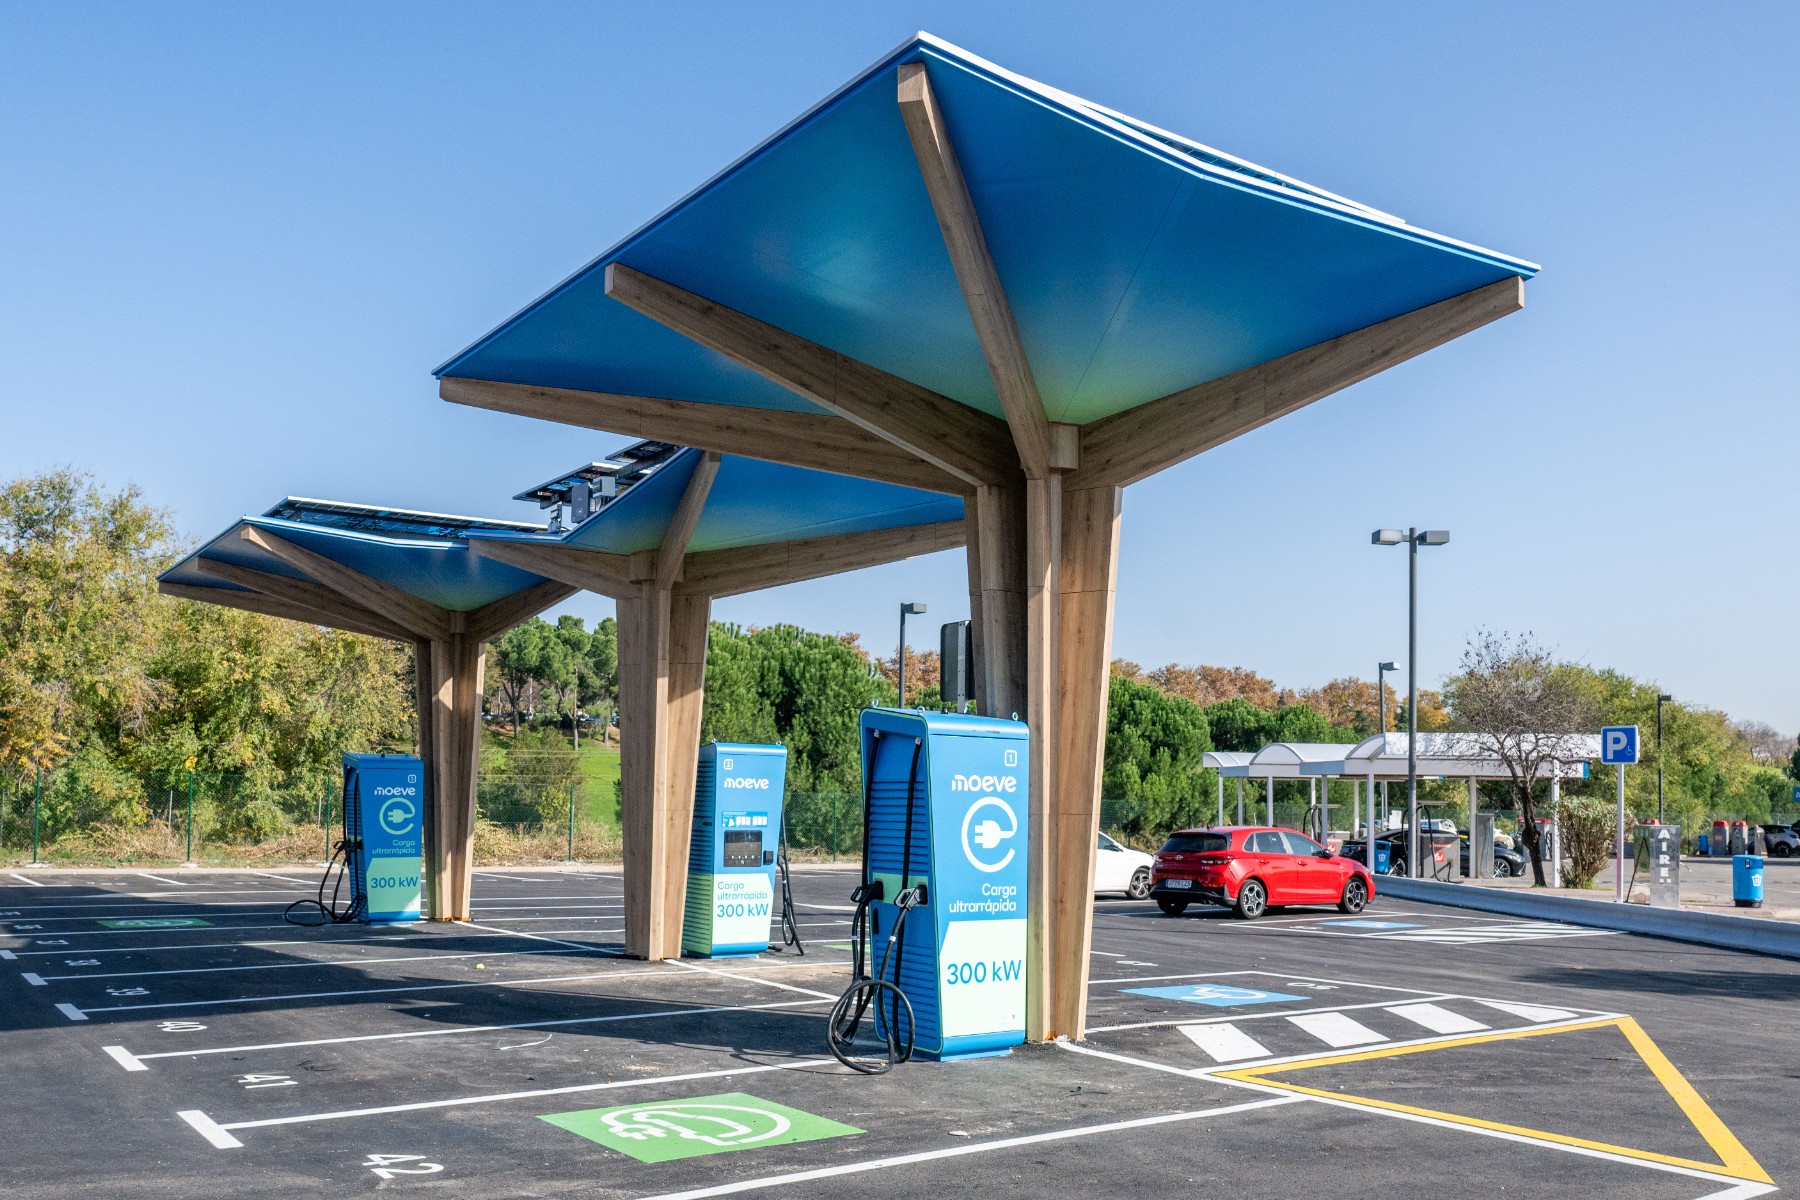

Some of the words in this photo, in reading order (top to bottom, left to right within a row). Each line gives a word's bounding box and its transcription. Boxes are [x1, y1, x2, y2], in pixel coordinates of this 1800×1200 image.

[1606, 731, 1628, 760] P
[724, 778, 769, 789] moeve
[952, 774, 1017, 793] moeve
[374, 787, 416, 796] moeve
[392, 840, 416, 848] Carga
[372, 847, 416, 855] ultrarrápida
[370, 877, 396, 889] 300
[398, 876, 418, 888] kW
[717, 881, 744, 891] Carga
[717, 891, 768, 900] ultrarrápida
[981, 883, 1017, 898] Carga
[717, 904, 744, 917] 300
[747, 903, 769, 916] kW
[949, 898, 1017, 914] ultrarrápida
[947, 961, 987, 985] 300
[992, 960, 1022, 981] kW
[156, 1021, 208, 1032] 40
[238, 1074, 299, 1089] 41
[361, 1153, 445, 1179] 42
